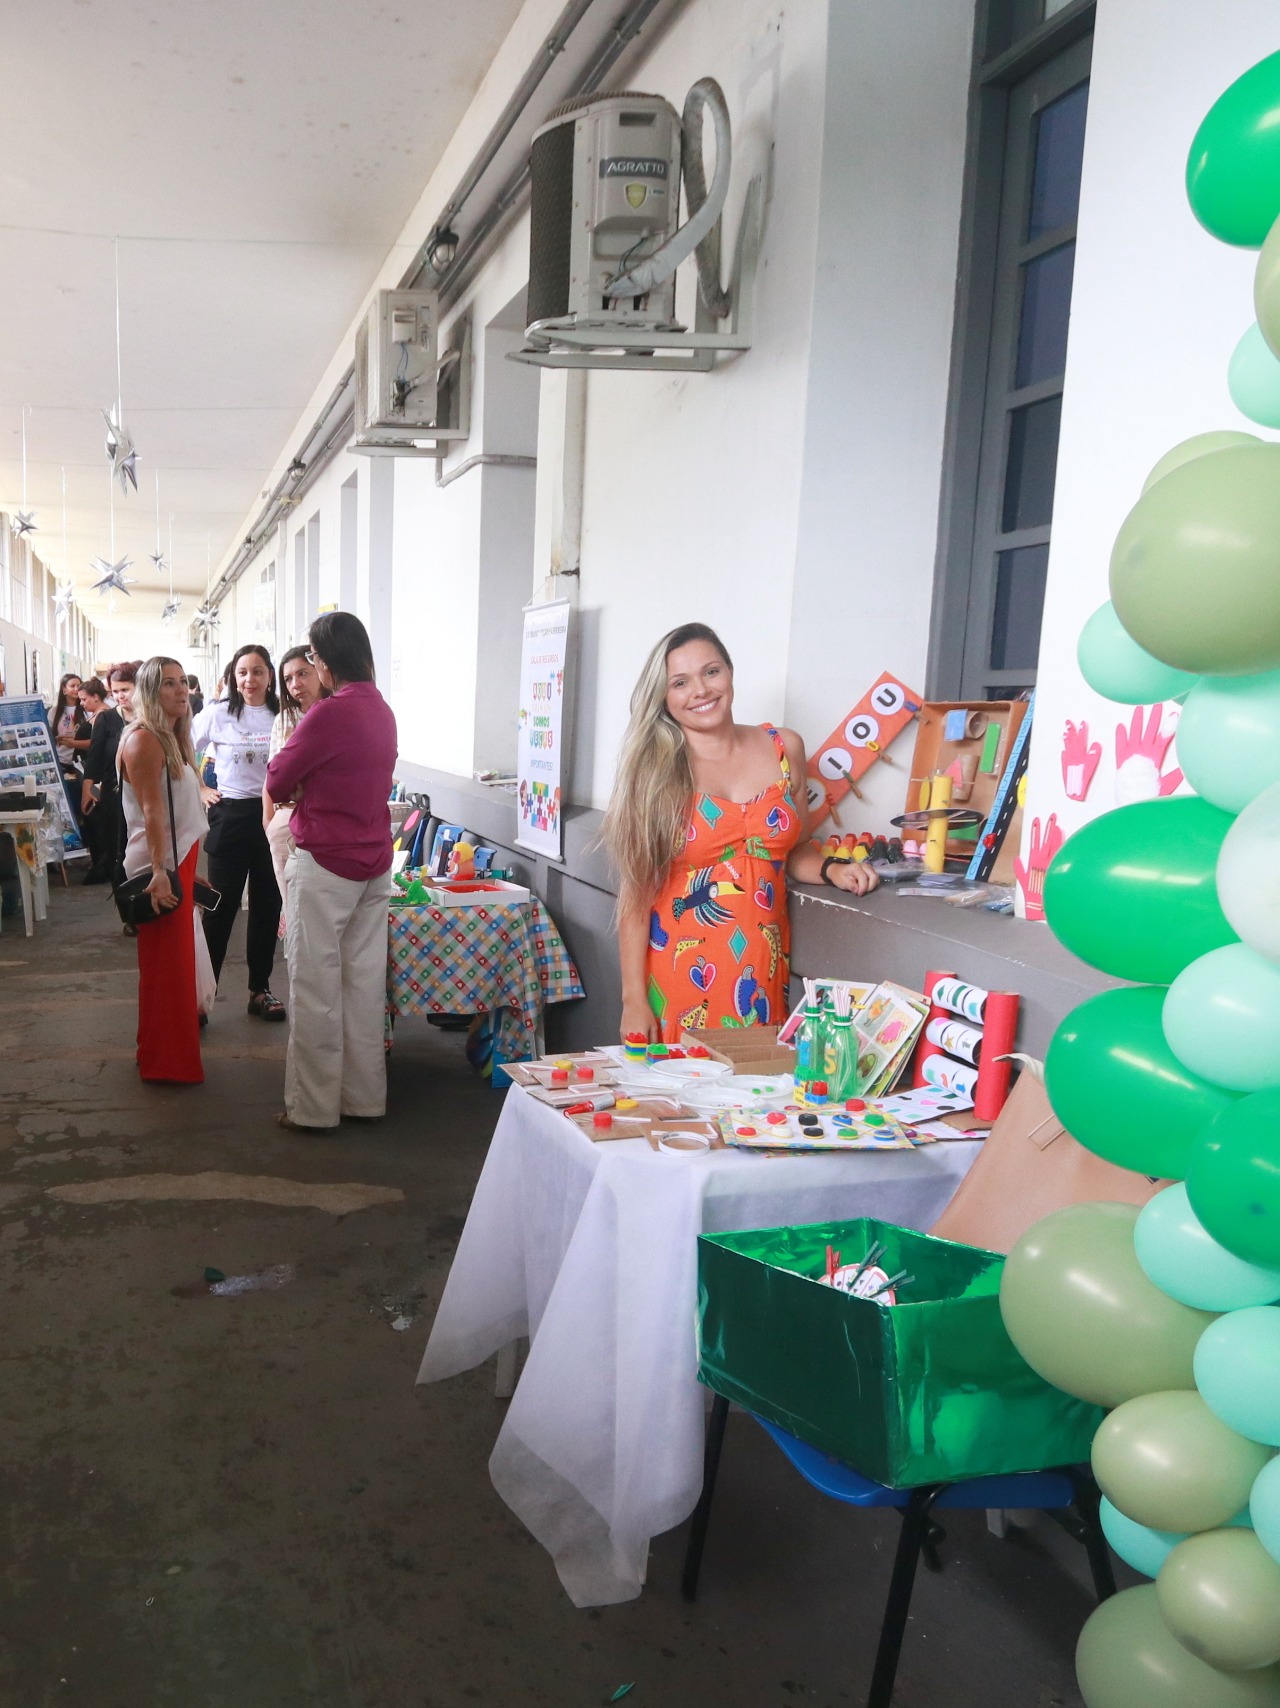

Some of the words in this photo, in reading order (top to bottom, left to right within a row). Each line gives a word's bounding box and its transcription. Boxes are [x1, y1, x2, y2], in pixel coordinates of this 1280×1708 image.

[606, 162, 665, 175] AGRATTO
[852, 721, 871, 740] O
[876, 688, 898, 708] U
[533, 716, 550, 727] SOMOS
